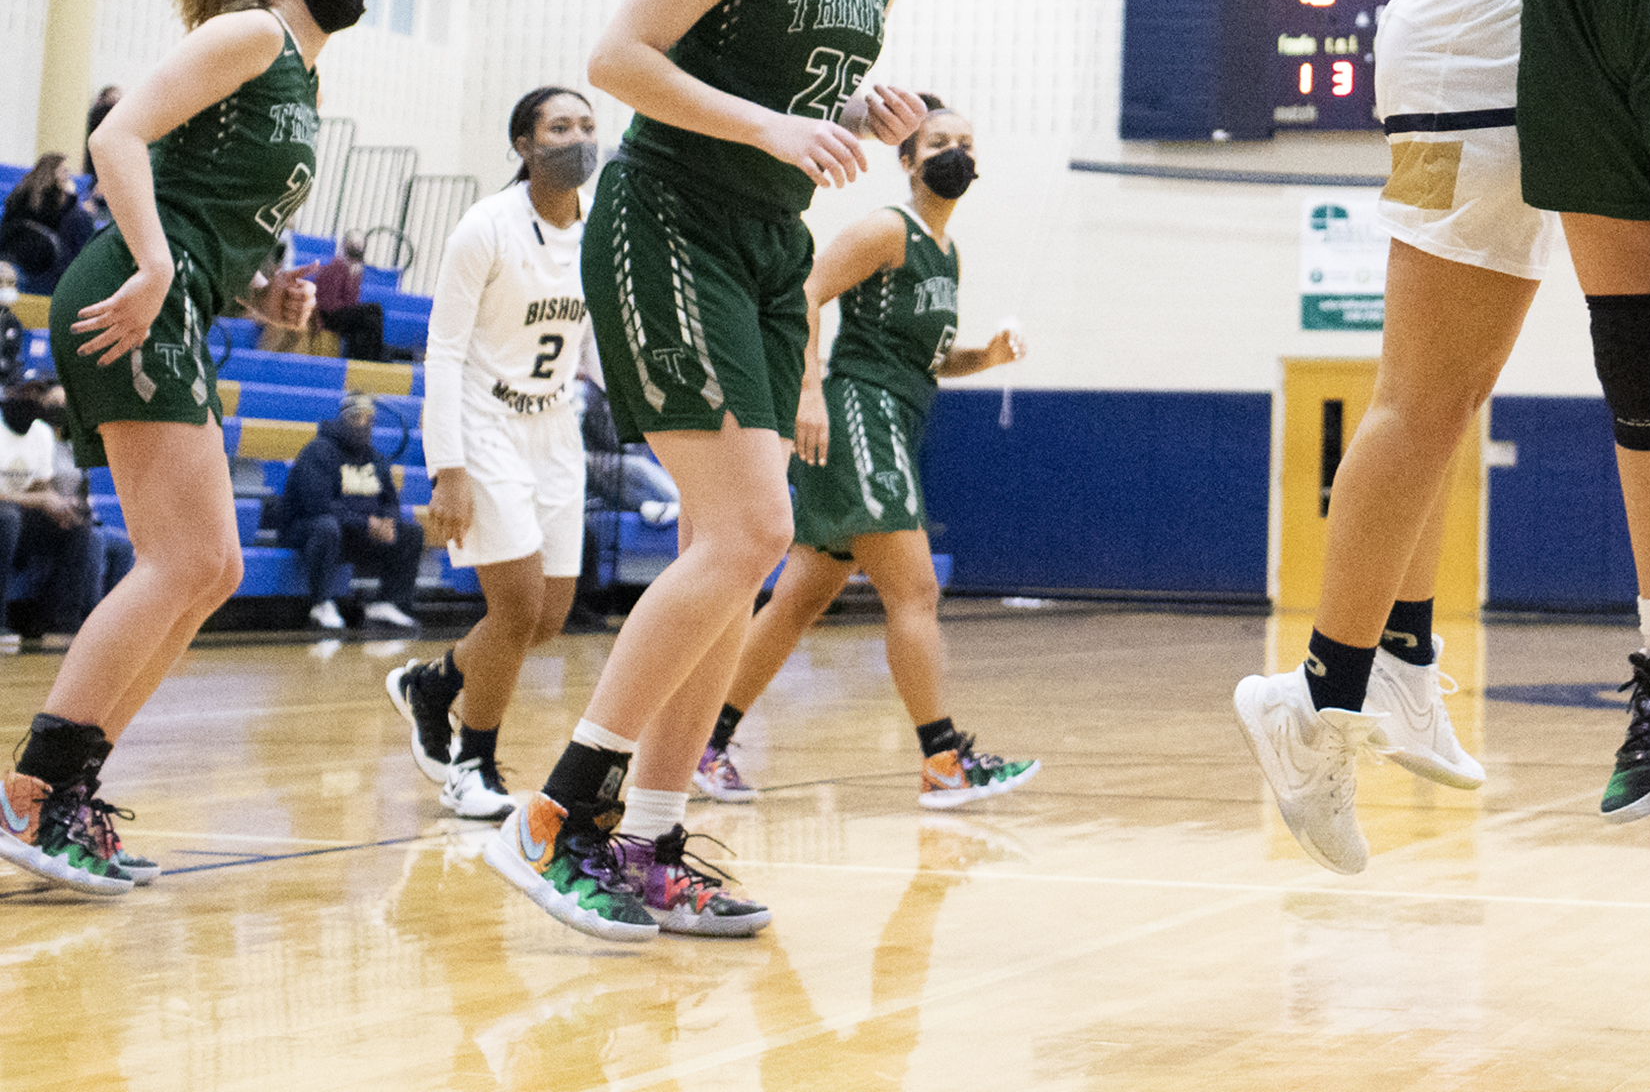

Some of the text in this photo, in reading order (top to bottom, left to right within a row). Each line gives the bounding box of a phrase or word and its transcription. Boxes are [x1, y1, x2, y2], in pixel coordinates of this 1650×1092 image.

[1299, 63, 1313, 94] 1
[1332, 61, 1354, 97] 3
[530, 334, 564, 378] 2
